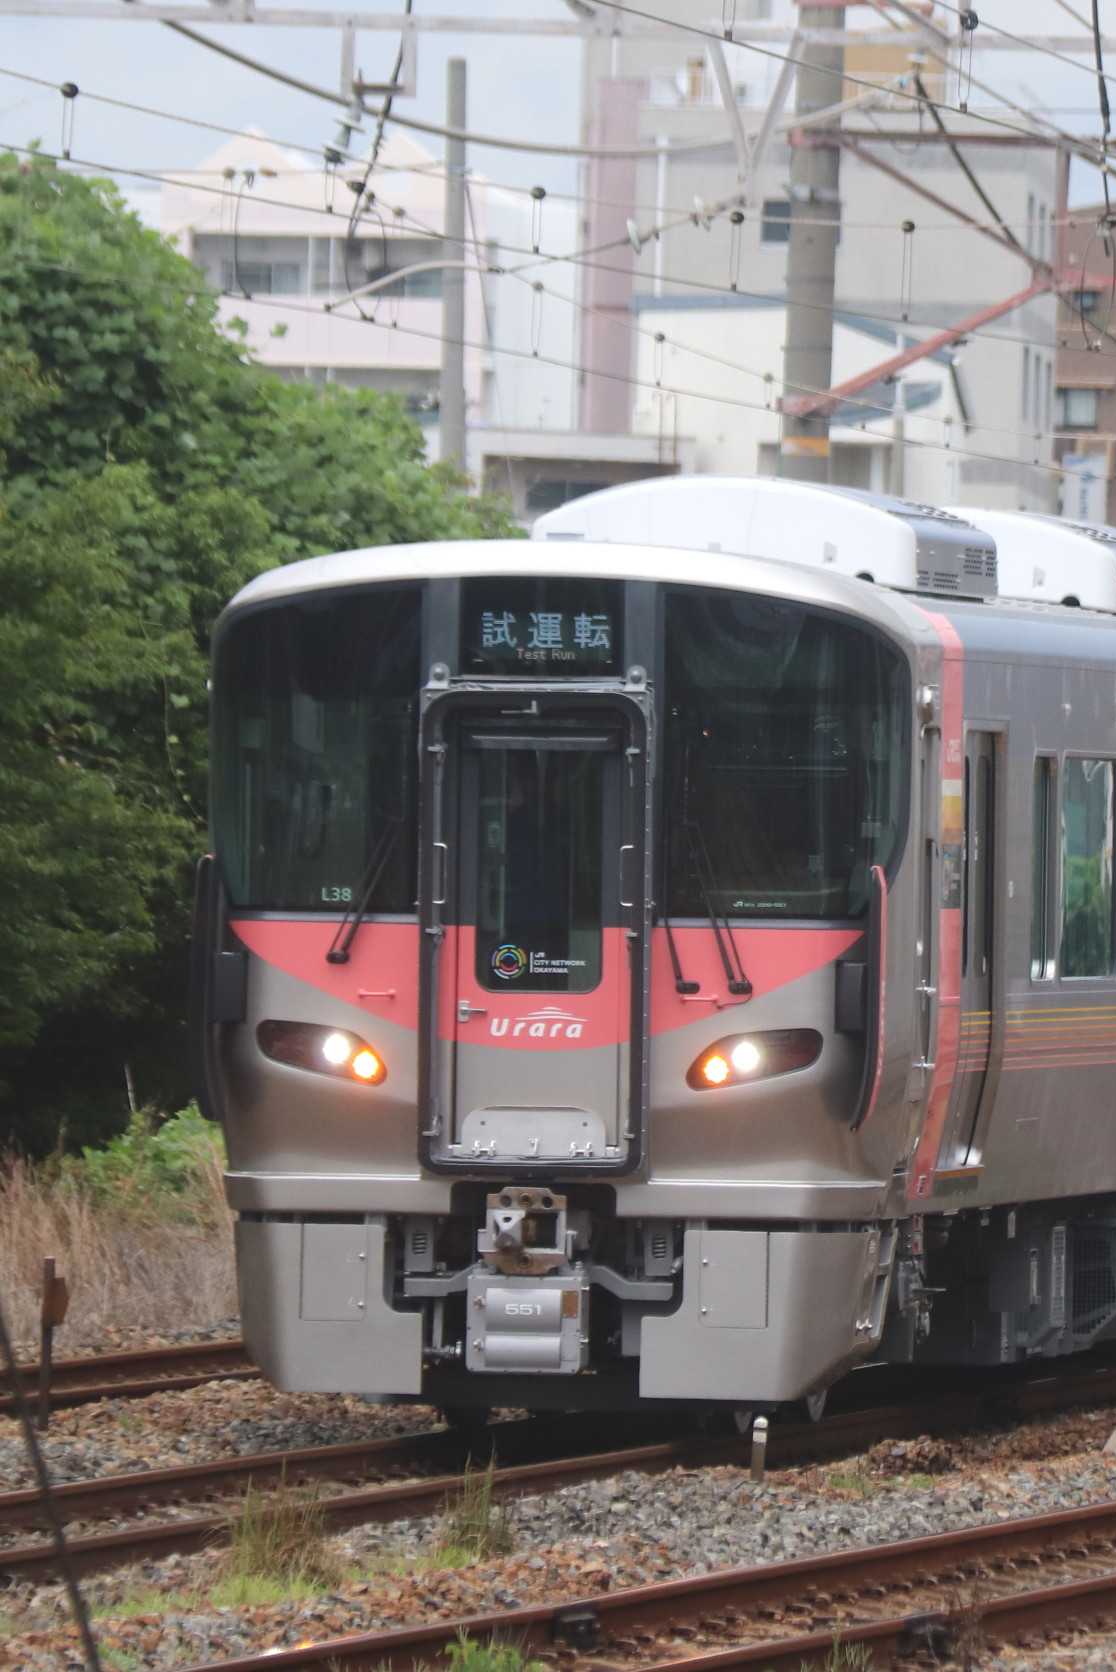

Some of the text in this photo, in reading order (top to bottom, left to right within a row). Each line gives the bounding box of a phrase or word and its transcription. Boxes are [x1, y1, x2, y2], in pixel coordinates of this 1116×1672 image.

[481, 611, 610, 649] 試運転
[516, 648, 576, 661] Test Run
[321, 887, 352, 901] L38
[489, 1017, 583, 1039] Urara
[504, 1303, 542, 1316] 551
